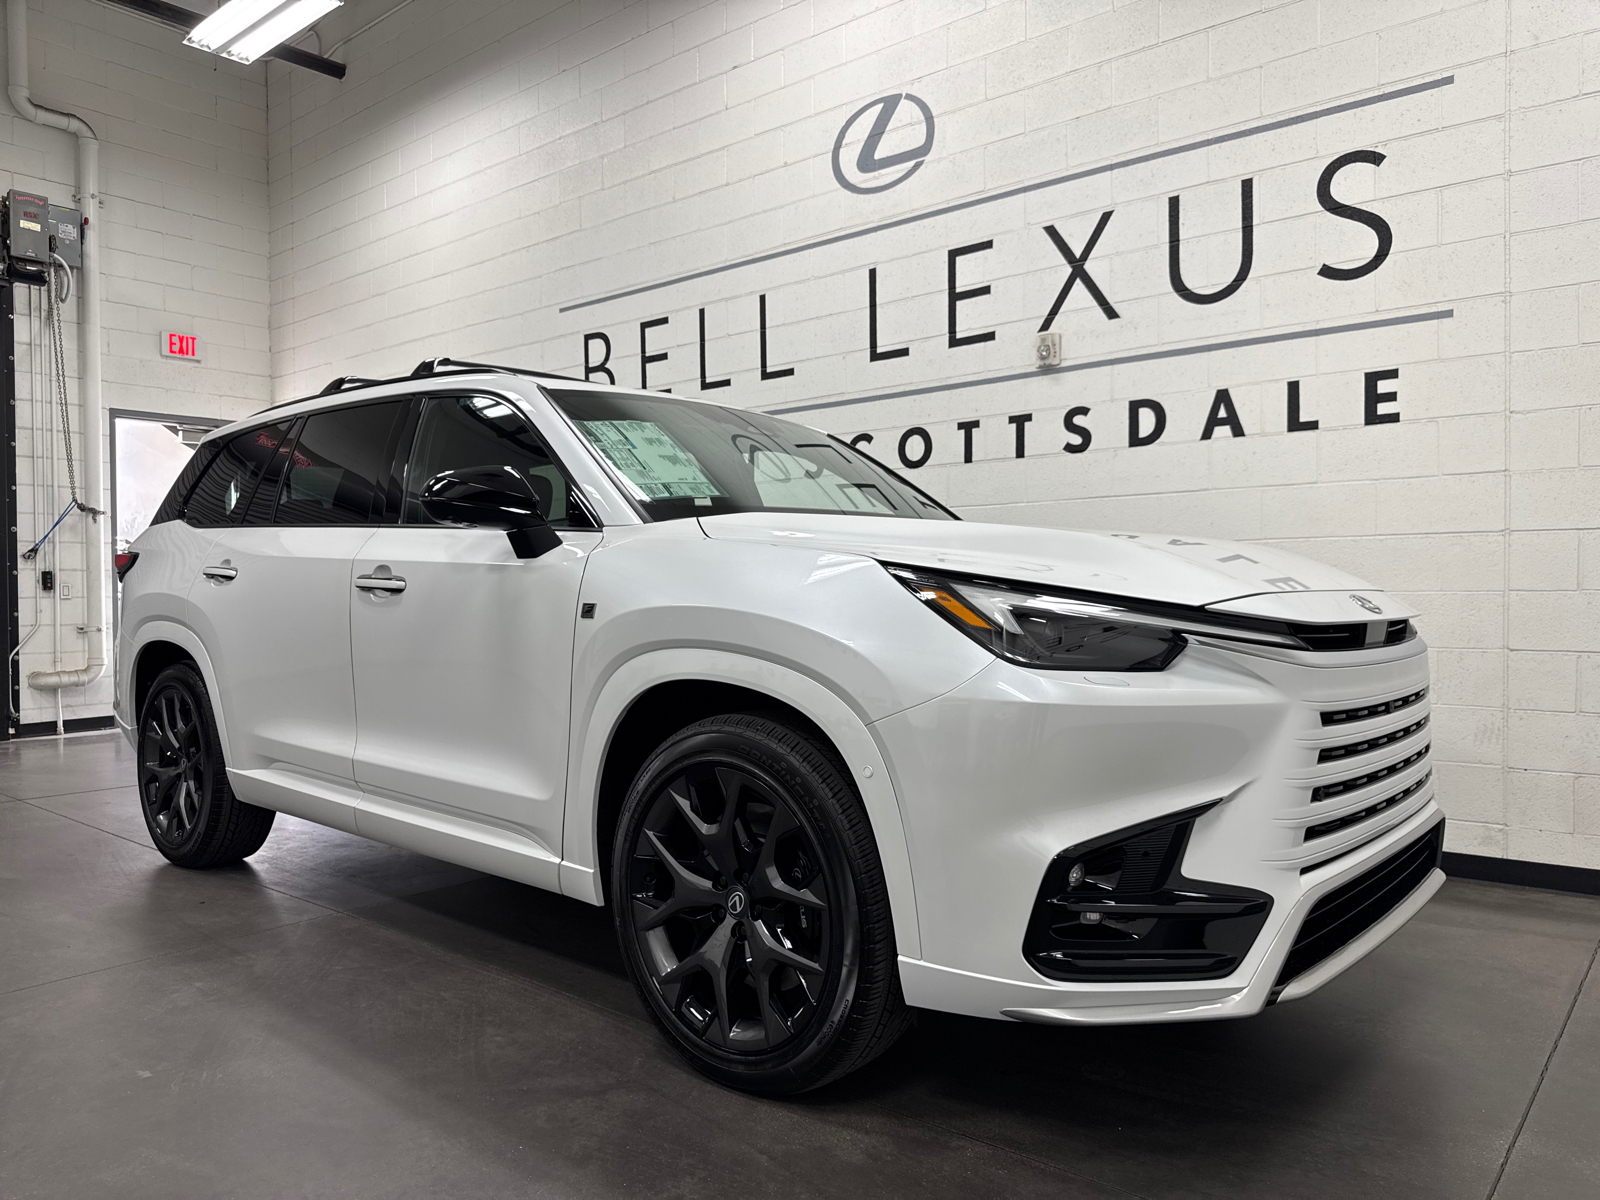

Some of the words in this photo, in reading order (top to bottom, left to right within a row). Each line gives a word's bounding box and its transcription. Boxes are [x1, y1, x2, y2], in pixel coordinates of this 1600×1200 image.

[583, 293, 795, 393] BELL
[868, 149, 1393, 362] LEXUS
[169, 333, 197, 357] EXIT
